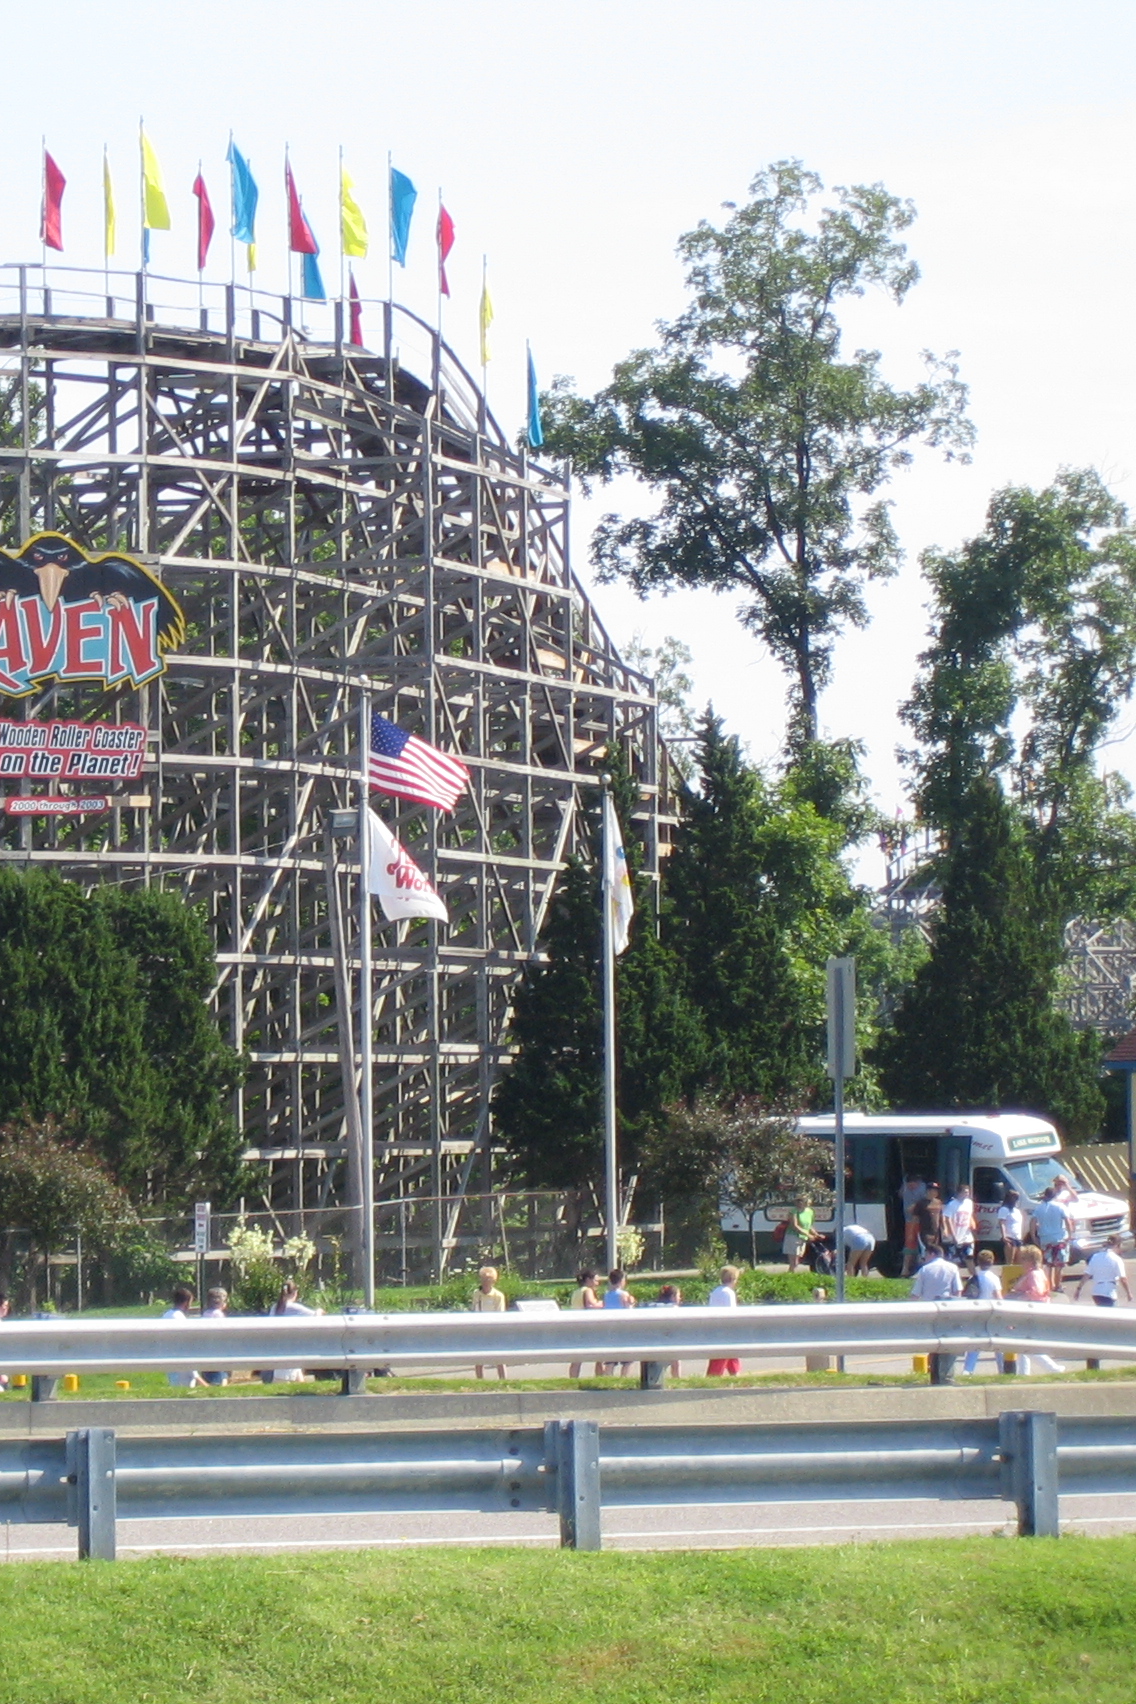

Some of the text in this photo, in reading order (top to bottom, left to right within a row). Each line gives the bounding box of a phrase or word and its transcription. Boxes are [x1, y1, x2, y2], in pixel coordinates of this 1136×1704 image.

[51, 725, 90, 749] Roller
[94, 726, 143, 750] Coaster
[0, 751, 142, 776] on the Planet!
[11, 800, 105, 812] 2000 through 2003
